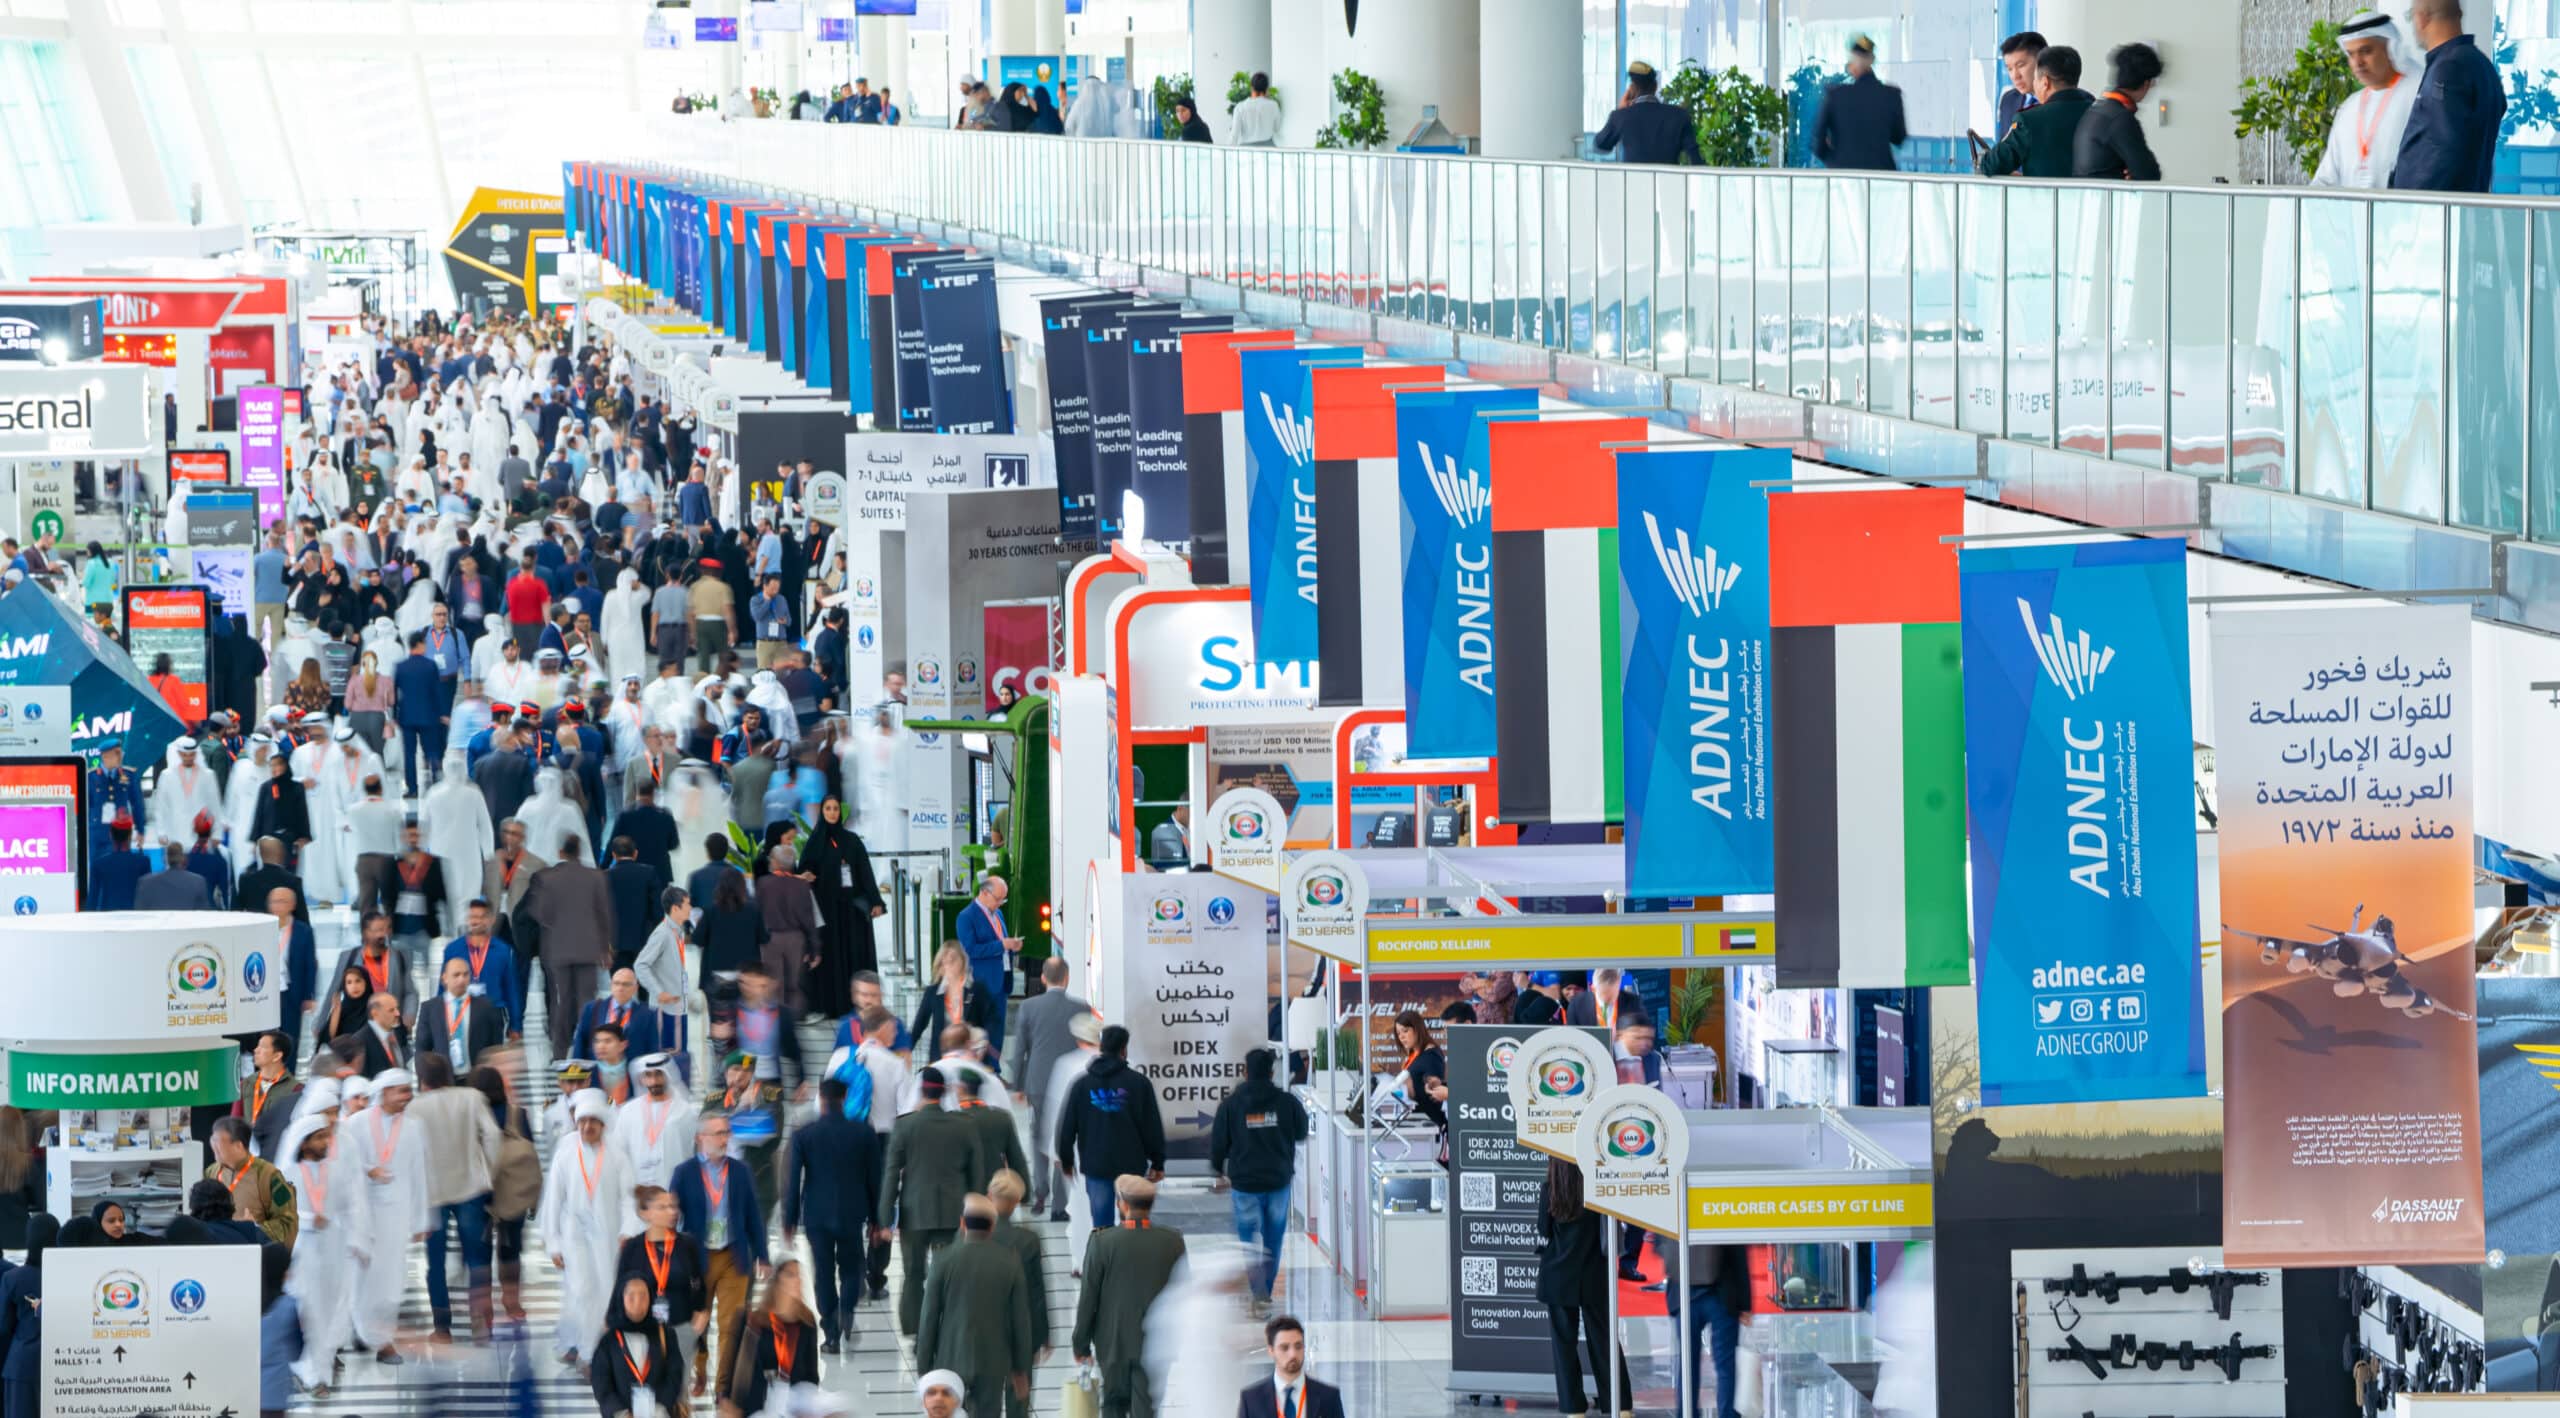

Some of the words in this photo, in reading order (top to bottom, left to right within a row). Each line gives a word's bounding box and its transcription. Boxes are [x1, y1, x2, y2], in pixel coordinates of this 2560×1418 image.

[921, 274, 979, 290] LITEF
[1047, 315, 1082, 331] LIT
[1087, 327, 1127, 342] LIT
[928, 343, 964, 354] Leading
[930, 353, 960, 364] Inertial
[931, 364, 981, 376] Technology
[1136, 430, 1182, 443] Leading
[1136, 445, 1178, 457] Inertial
[32, 497, 62, 508] HALL
[865, 490, 905, 502] CAPITAL
[860, 507, 894, 519] SUITES
[37, 519, 59, 537] 13
[969, 547, 980, 560] 30
[981, 546, 1008, 559] YEARS
[1009, 542, 1064, 557] CONNECTING
[1066, 541, 1083, 553] THE
[1455, 542, 1493, 695] ADNEC
[1752, 639, 1763, 672] Centre
[2302, 656, 2366, 690] فخور
[2376, 655, 2451, 688] شريك
[1190, 699, 1265, 711] PROTECTING
[1267, 697, 1303, 708] THOSE
[1753, 673, 1763, 722] Exhibition
[2249, 697, 2359, 725] المسلحة
[2369, 693, 2451, 728] للقوات
[1687, 634, 1732, 820] ADNEC
[1263, 737, 1281, 745] USD
[1285, 737, 1300, 745] 100
[1304, 736, 1331, 744] Million
[2127, 720, 2137, 752] Centre
[1213, 747, 1236, 756] Bullet
[1239, 747, 1261, 755] Proof
[1264, 746, 1295, 755] Jackets
[1754, 724, 1764, 766] National
[2388, 733, 2451, 767] لدولة
[2281, 736, 2379, 772] الإمارات
[1755, 768, 1765, 799] Dhabi
[2129, 754, 2138, 801] Exhibition
[2256, 775, 2356, 805] المتحدة
[2366, 773, 2453, 808] العربية
[1756, 801, 1765, 820] Abu
[2063, 717, 2110, 898] ADNEC
[912, 812, 947, 824] ADNEC
[2130, 803, 2140, 845] National
[2281, 819, 2341, 844] ١٩٧٢
[2350, 818, 2401, 842] سنة
[2411, 816, 2455, 841] منذ
[0, 839, 49, 858] LACE
[1221, 857, 1236, 867] 30
[1238, 857, 1274, 867] YEARS
[2131, 844, 2141, 877] Dhabi
[2133, 878, 2142, 897] Abu
[1297, 926, 1314, 937] 30
[1316, 926, 1355, 937] YEARS
[1377, 940, 1438, 952] ROCKFORD
[1440, 939, 1491, 951] XELLERIK
[1166, 960, 1224, 979] مكتب
[2032, 960, 2146, 988] adnec.ae
[1156, 984, 1234, 1003] منظمين
[1161, 1006, 1230, 1027] آيدكس
[1344, 1003, 1396, 1017] LEVEL
[168, 1015, 186, 1026] 30
[188, 1012, 228, 1025] YEARS
[1173, 1040, 1218, 1056] IDEX
[2036, 1029, 2148, 1057] ADNECGROUP
[26, 1070, 199, 1095] INFORMATION
[1459, 1104, 1498, 1120] Scan
[1528, 1122, 1548, 1134] 30
[1468, 1138, 1490, 1149] IDEX
[1492, 1138, 1515, 1149] 2023
[1468, 1149, 1501, 1160] Official
[1503, 1150, 1528, 1161] Show
[1502, 1181, 1541, 1192] NAVDEX
[1595, 1184, 1617, 1198] 30
[1619, 1183, 1671, 1197] YEARS
[1502, 1193, 1535, 1203] Official
[2391, 1198, 2465, 1212] DASSAULT
[1703, 1201, 1776, 1215] EXPLORER
[1779, 1200, 1825, 1214] CASES
[1828, 1199, 1847, 1213] BY
[1850, 1199, 1870, 1213] GT
[1872, 1199, 1905, 1213] LINE
[2390, 1210, 2458, 1223] AVIATION
[1470, 1222, 1491, 1233] IDEX
[1494, 1223, 1532, 1233] NAVDEX
[1470, 1234, 1502, 1245] Official
[1504, 1235, 1535, 1246] Pocket
[1504, 1266, 1526, 1277] IDEX
[1504, 1278, 1536, 1289] Mobile
[1471, 1306, 1520, 1318] Innovation
[1471, 1318, 1499, 1329] Guide
[54, 1357, 83, 1366] HALLS
[54, 1386, 73, 1396] LIVE
[74, 1386, 149, 1395] DEMONSTRATION
[150, 1385, 172, 1394] AREA
[55, 1406, 66, 1415] 13
